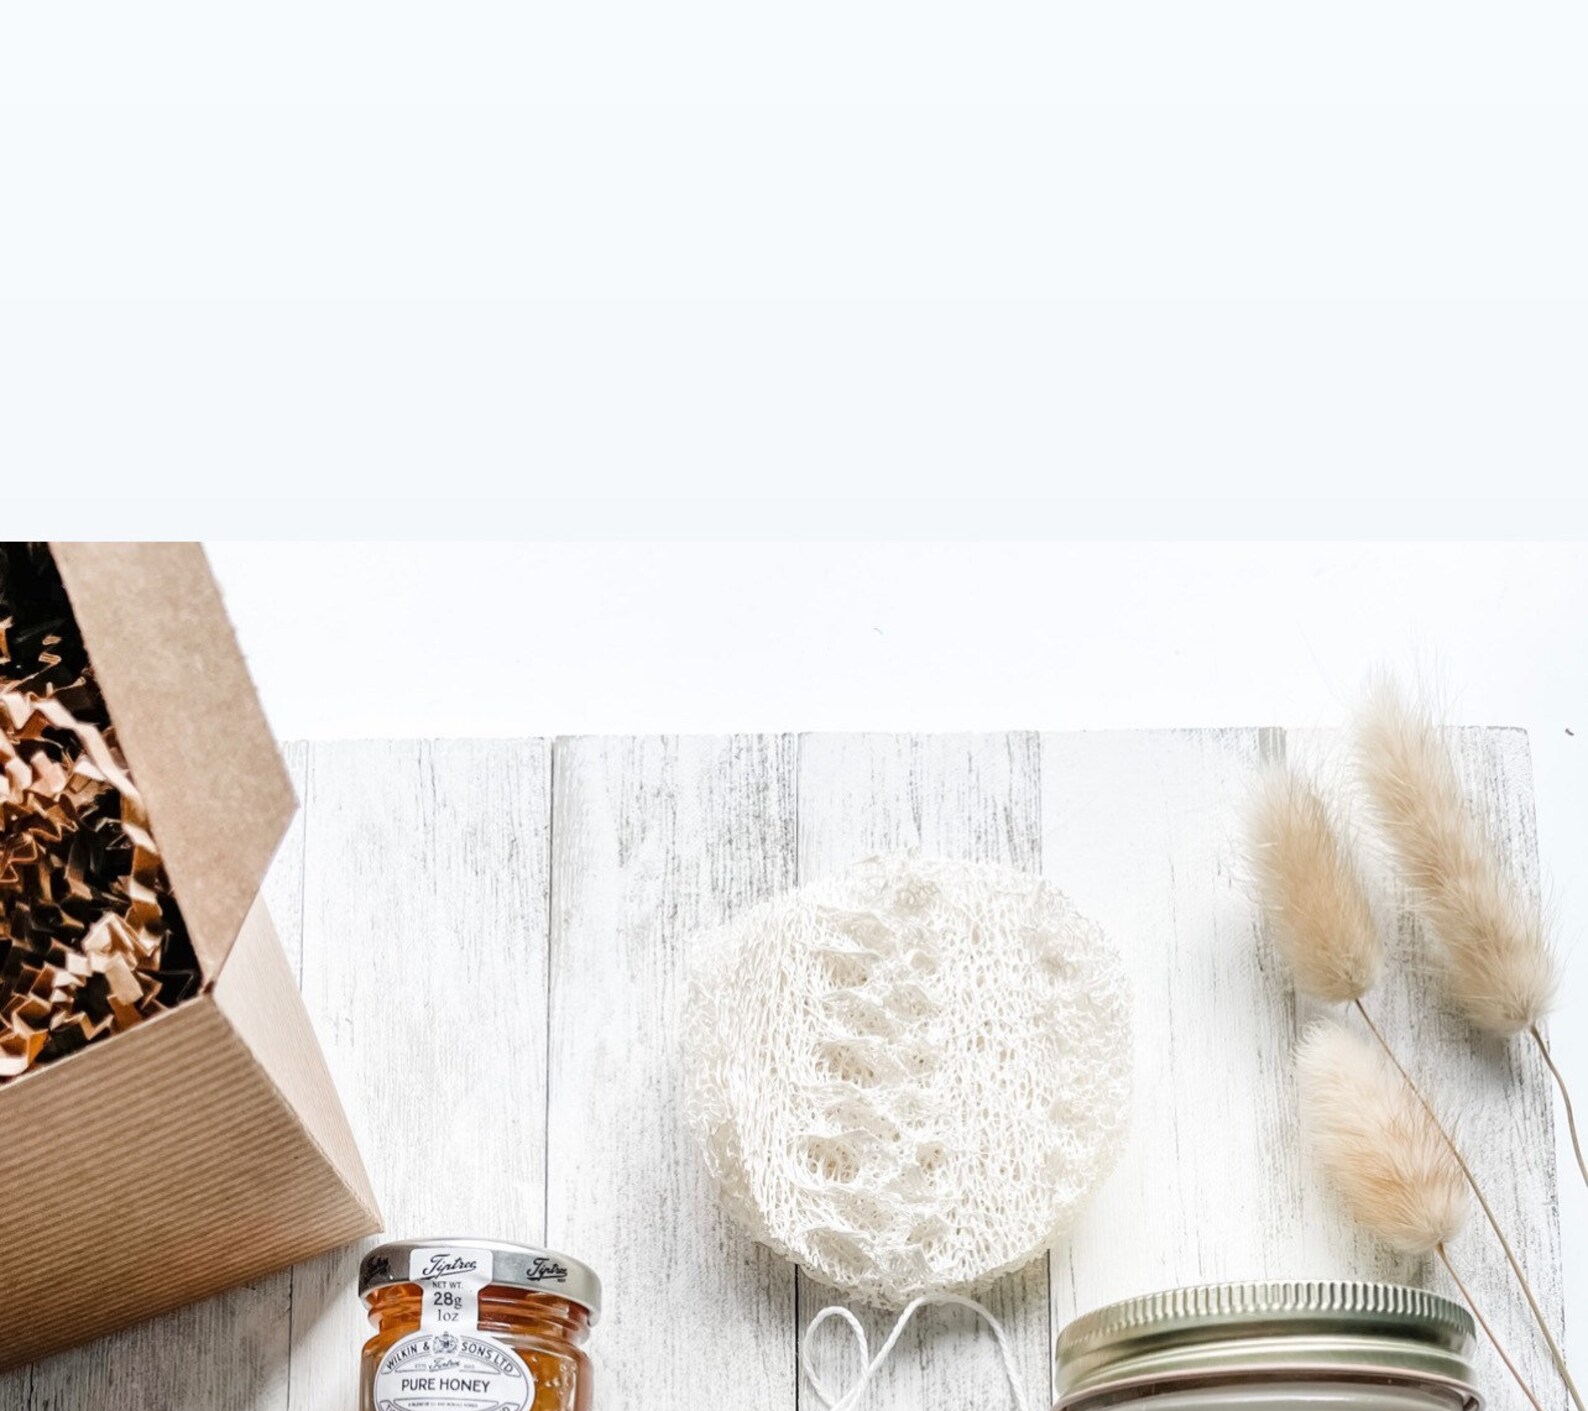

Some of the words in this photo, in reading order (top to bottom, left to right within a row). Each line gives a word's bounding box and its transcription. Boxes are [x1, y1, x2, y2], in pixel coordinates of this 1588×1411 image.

[421, 1253, 477, 1279] Tiptree
[432, 1280, 447, 1289] NET
[433, 1291, 462, 1310] 28g
[437, 1309, 459, 1322] 1oz
[386, 1343, 418, 1370] WILKIN
[423, 1341, 430, 1351] &
[461, 1341, 493, 1360] SONS
[493, 1353, 514, 1373] LTD
[401, 1378, 436, 1392] PURE
[439, 1378, 491, 1393] HONEY
